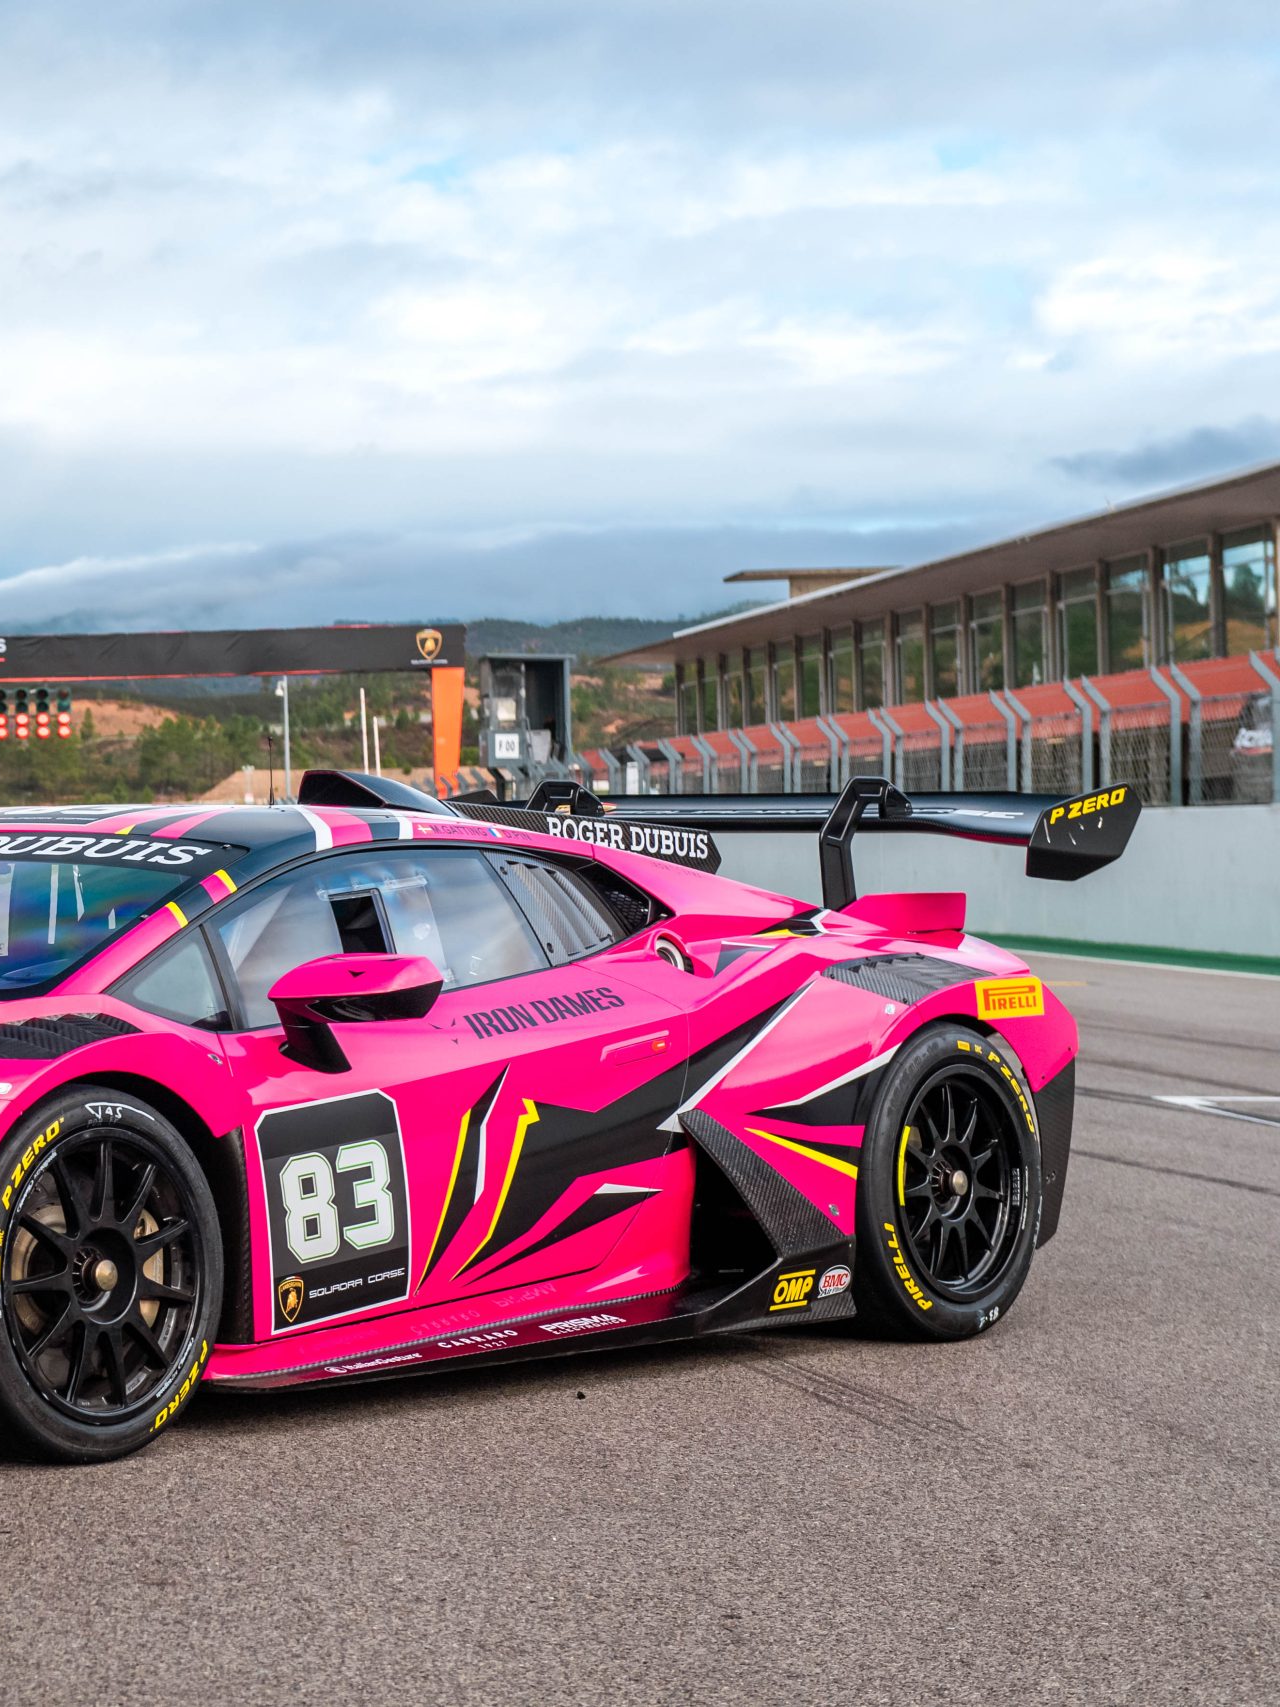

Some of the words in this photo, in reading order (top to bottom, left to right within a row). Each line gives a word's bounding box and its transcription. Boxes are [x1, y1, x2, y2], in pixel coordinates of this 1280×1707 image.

[1049, 806, 1066, 825] P
[1067, 788, 1126, 820] ZERO
[546, 816, 626, 850] ROGER
[629, 830, 710, 860] DUBUIS
[463, 1004, 538, 1040] IRON
[529, 986, 625, 1024] DAMES
[982, 984, 1037, 1012] PIRELLI
[987, 1051, 1001, 1063] P
[2, 1184, 13, 1211] P
[11, 1120, 61, 1189] ZERO
[279, 1139, 395, 1265] 83
[822, 1273, 849, 1289] BMC
[883, 1222, 934, 1311] PIRELLI
[308, 1278, 363, 1299] SQUADRA
[367, 1267, 406, 1284] CORSE
[773, 1276, 814, 1304] OMP
[539, 1313, 622, 1332] PRISMA
[437, 1330, 519, 1349] CARRARO
[478, 1341, 508, 1350] 1927
[154, 1360, 200, 1429] ZERO
